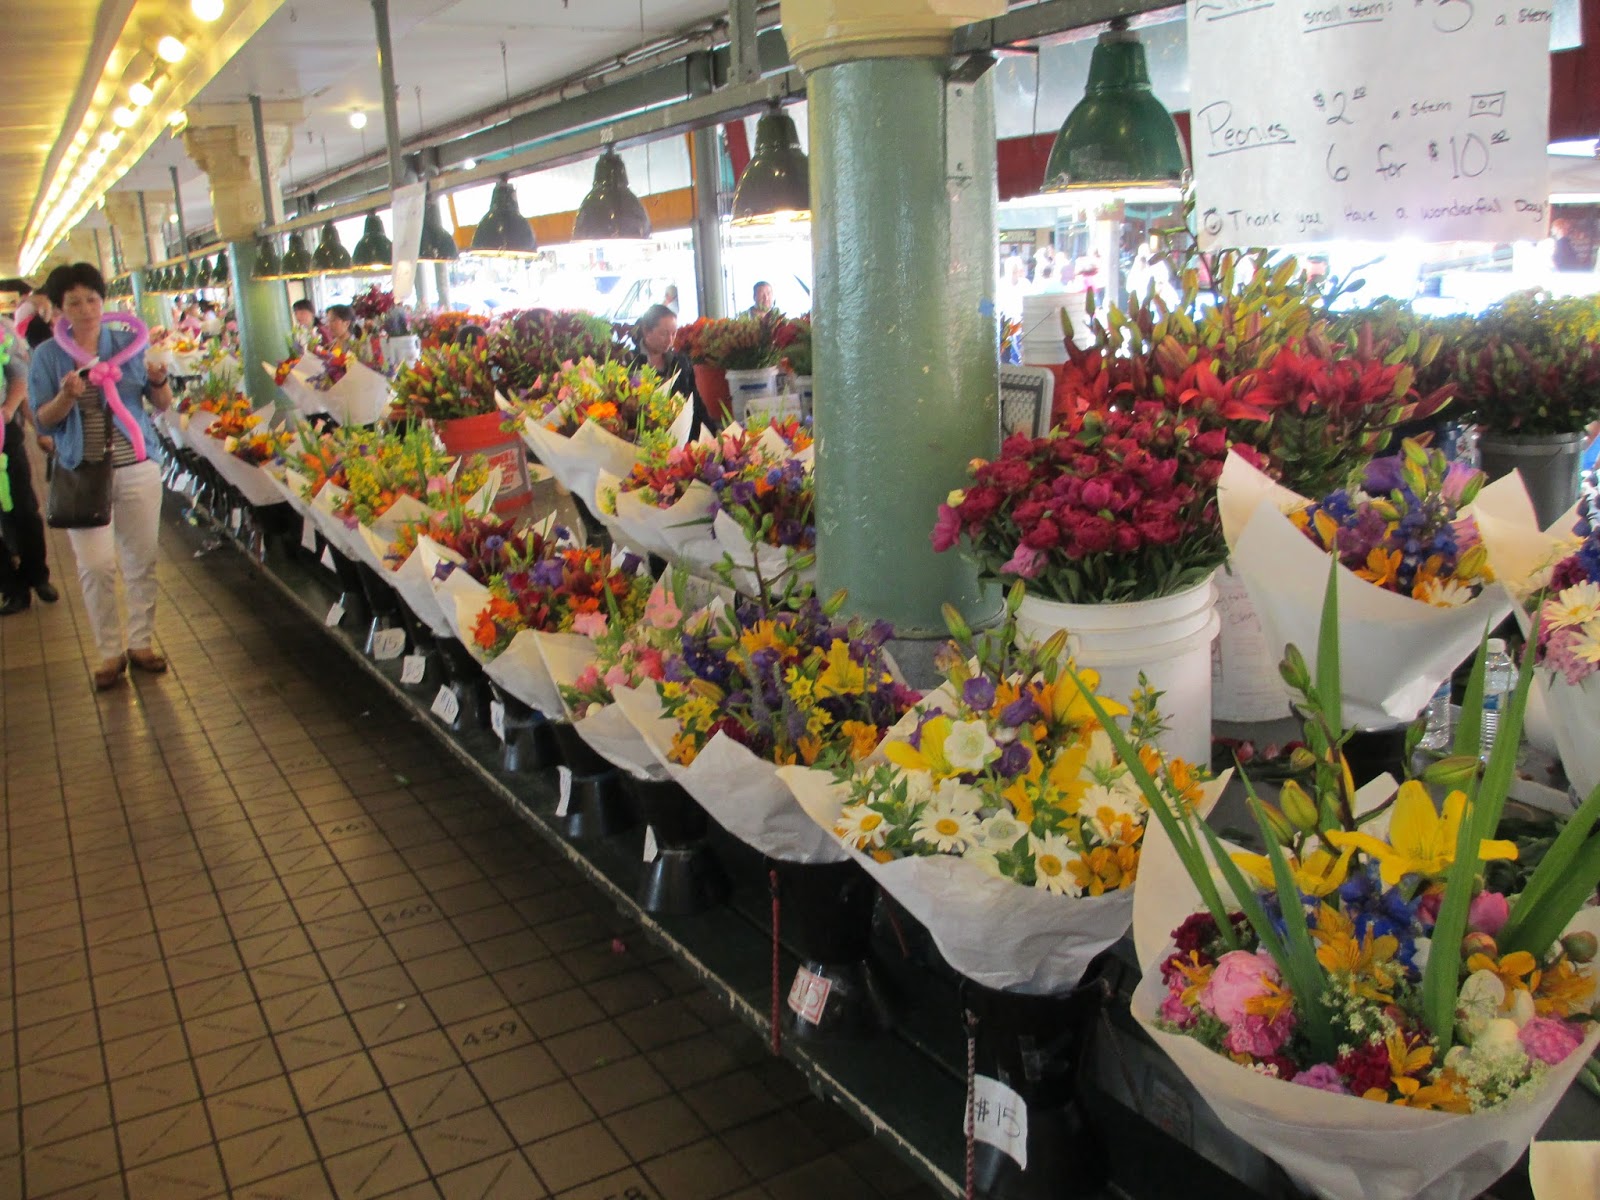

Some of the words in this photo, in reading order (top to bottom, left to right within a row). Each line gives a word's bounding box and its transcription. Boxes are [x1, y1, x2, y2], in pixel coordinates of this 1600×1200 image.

[1326, 143, 1350, 182] 6
[1375, 143, 1407, 181] for
[1227, 209, 1281, 231] Thank
[1395, 207, 1409, 220] a
